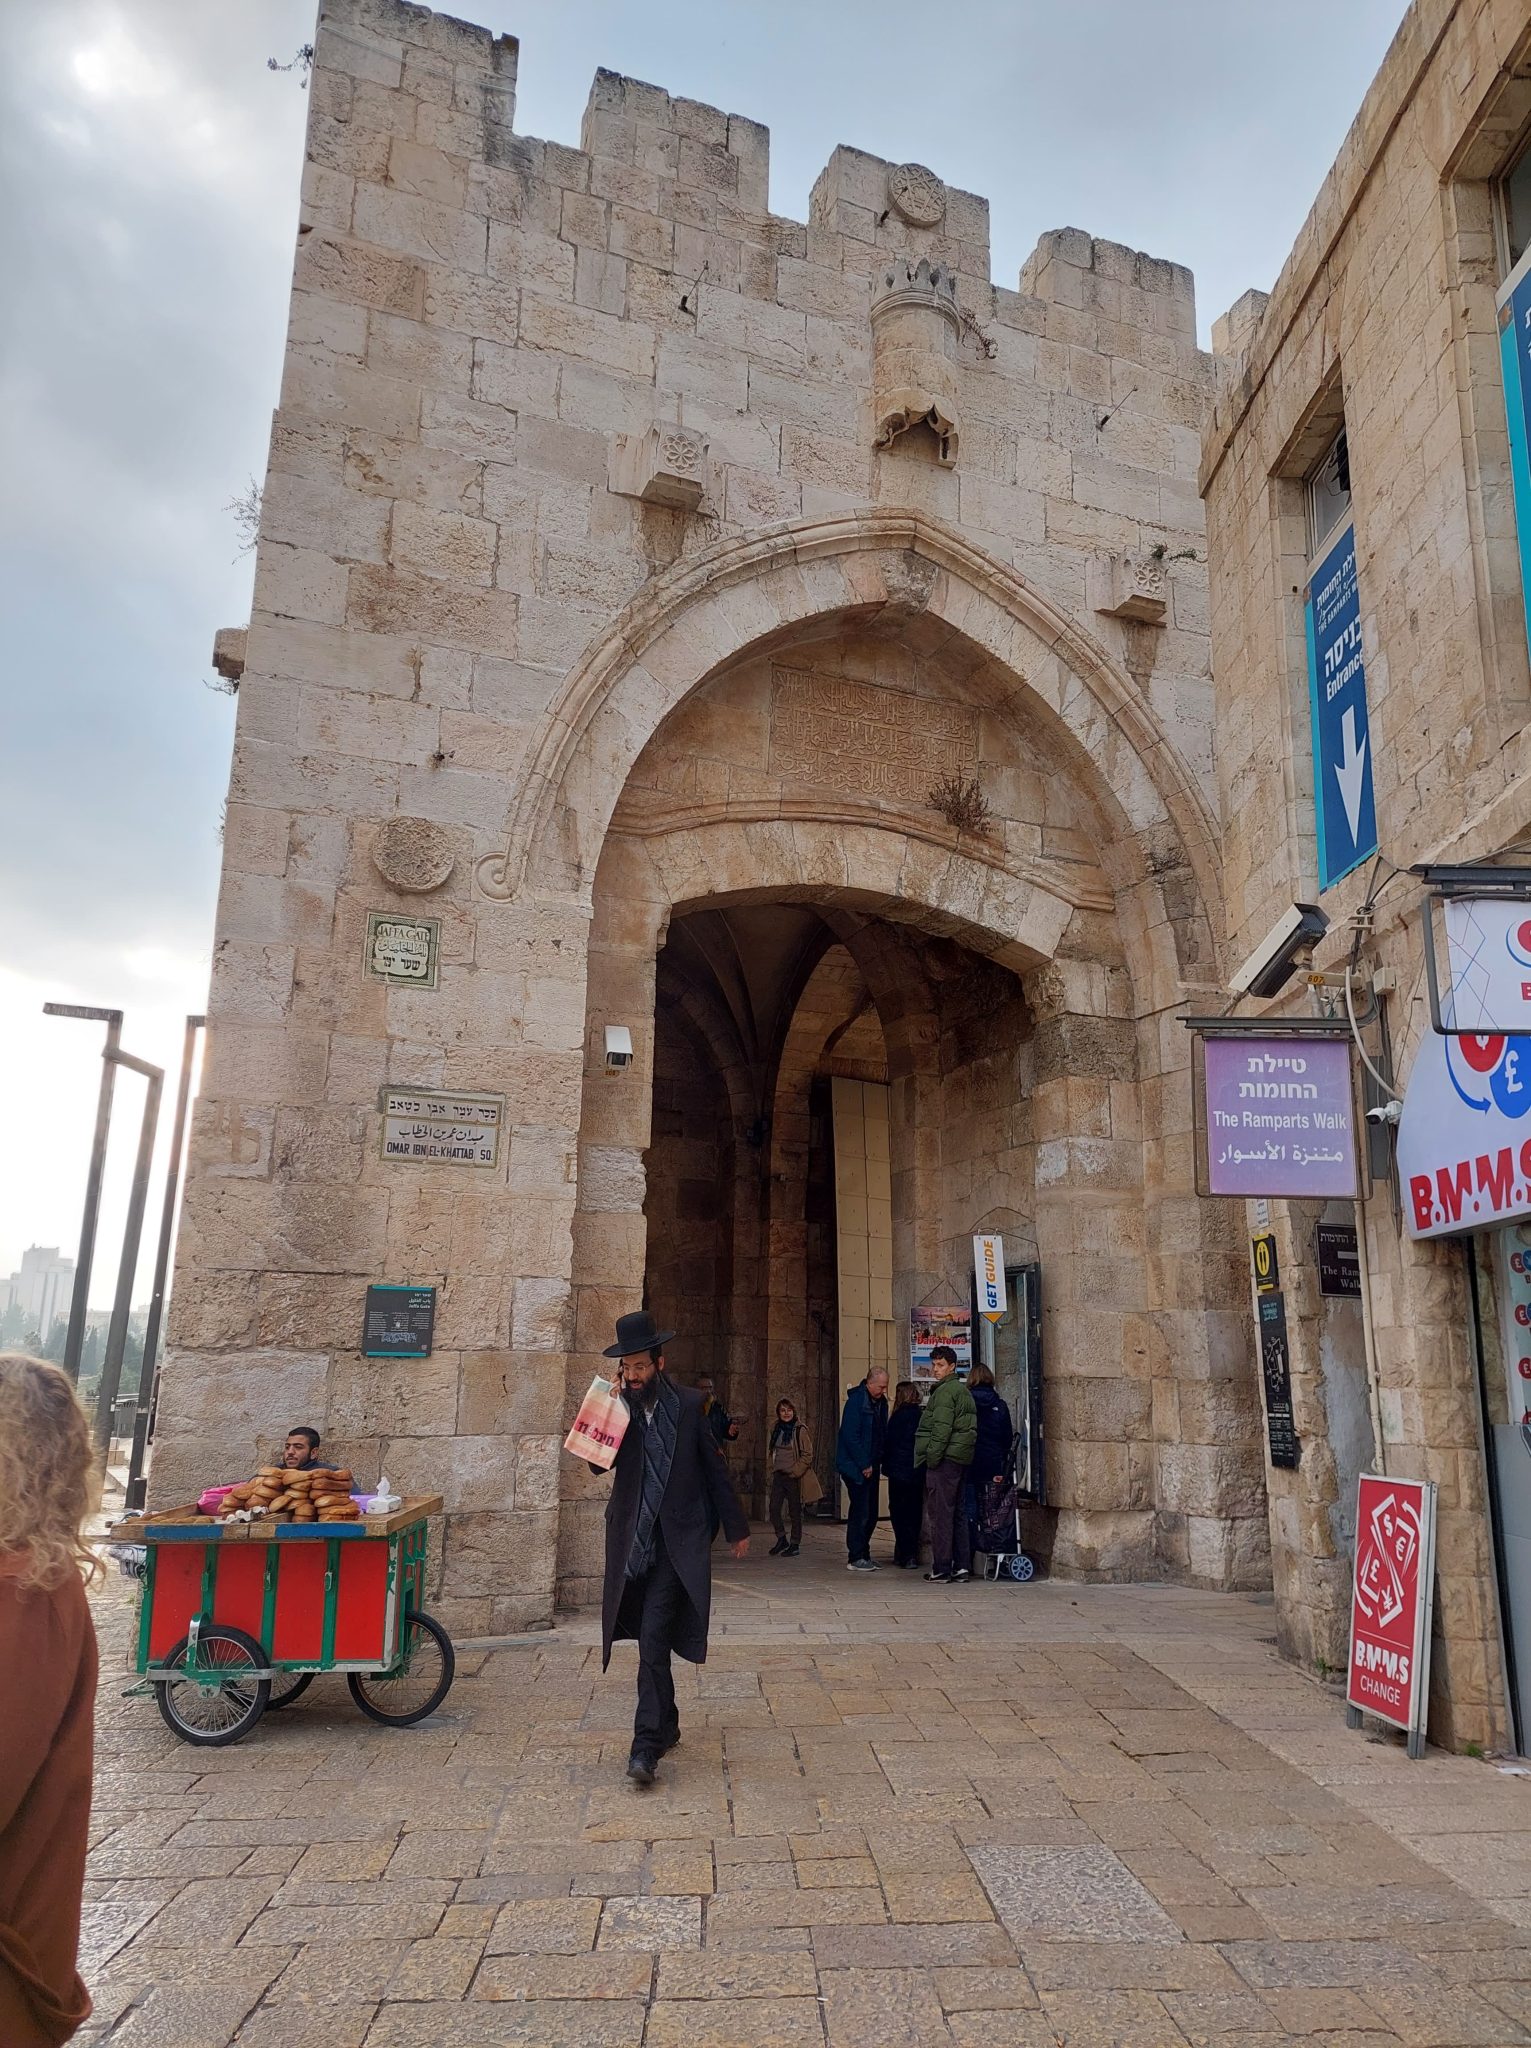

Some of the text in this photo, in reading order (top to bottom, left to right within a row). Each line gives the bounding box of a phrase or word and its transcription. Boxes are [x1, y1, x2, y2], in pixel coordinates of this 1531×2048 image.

[1327, 587, 1351, 624] RAMPARTS
[1326, 648, 1364, 703] Entrance
[378, 925, 405, 938] JAFFA
[401, 958, 420, 970] שער
[1247, 1054, 1307, 1074] טיילת
[1239, 1082, 1318, 1099] החומות
[1213, 1111, 1347, 1132] The Ramparts Walk
[399, 1124, 432, 1139] الخطاب
[456, 1129, 484, 1144] ميدان
[387, 1142, 410, 1155] OMAR
[413, 1144, 427, 1156] IBN
[429, 1145, 474, 1160] EL-KHATTAB
[1322, 1265, 1338, 1276] The
[917, 1335, 938, 1347] Daily
[1360, 1675, 1400, 1706] CHANGE
